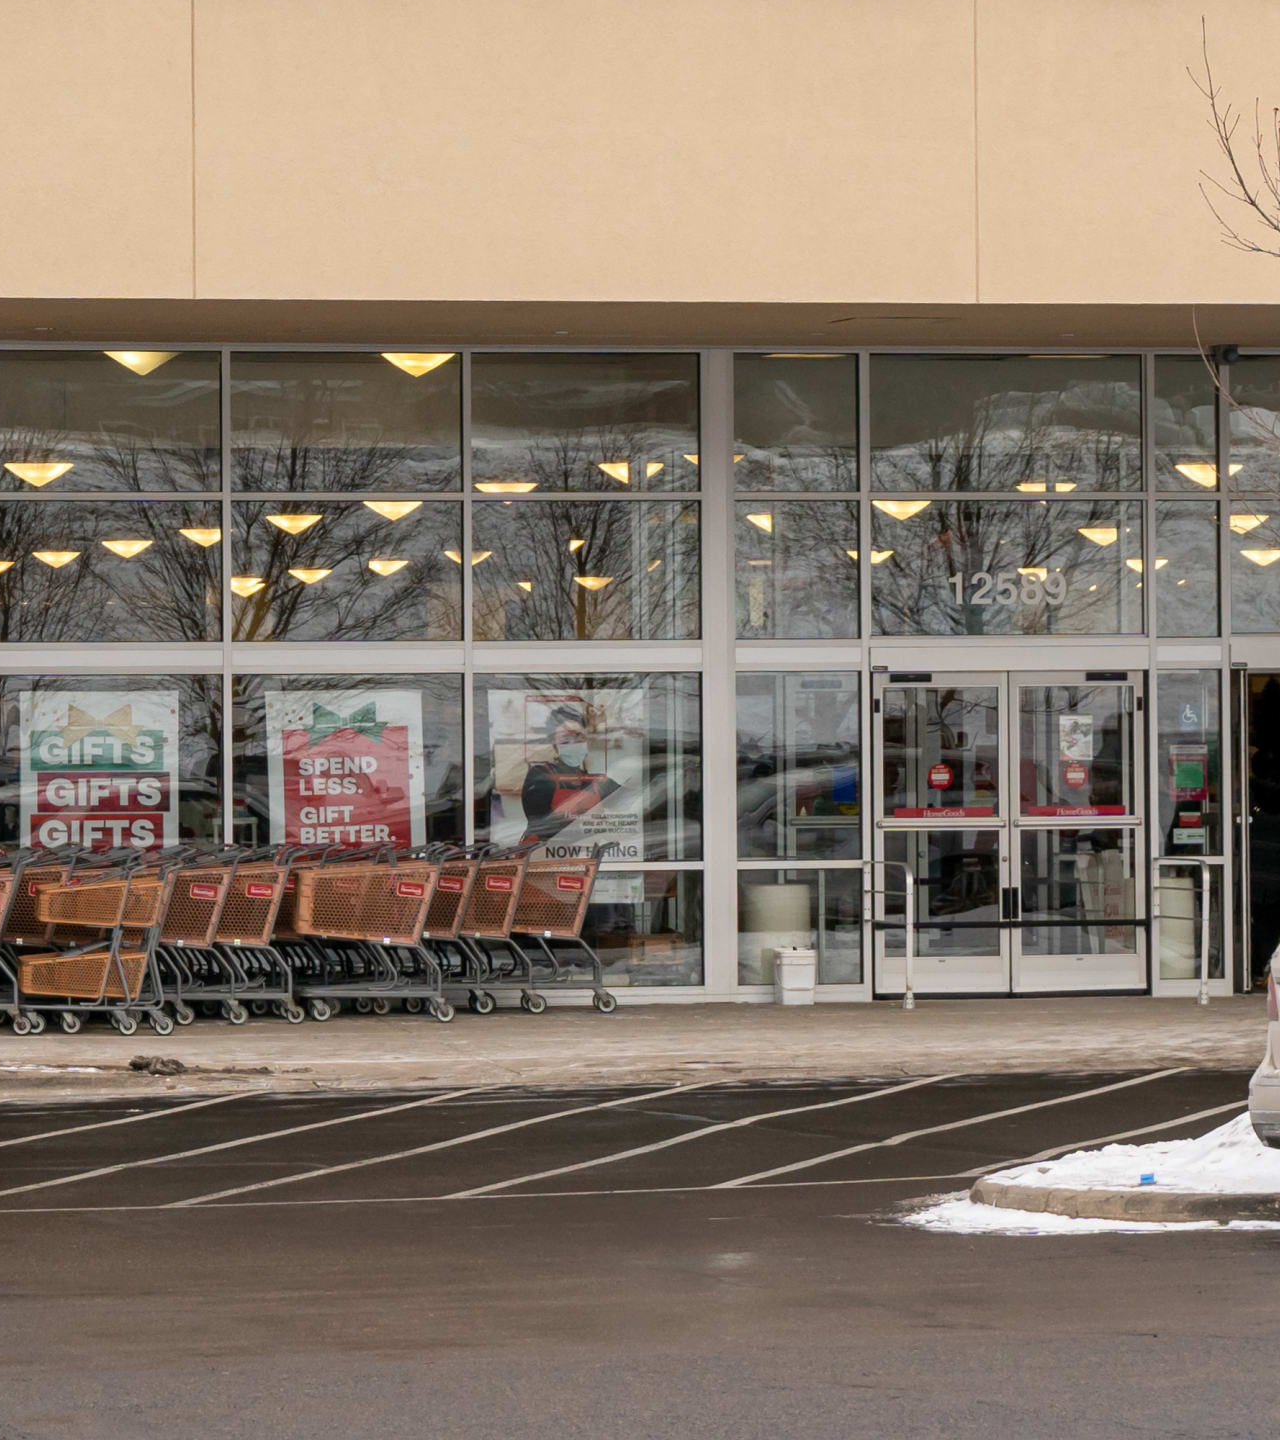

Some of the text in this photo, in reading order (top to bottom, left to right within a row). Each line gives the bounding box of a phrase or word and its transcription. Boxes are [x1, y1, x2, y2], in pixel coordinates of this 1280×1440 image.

[948, 571, 1068, 605] 12589
[38, 735, 156, 765] GIFTS
[298, 755, 378, 776] SPEND
[45, 777, 162, 807] GIFTS
[299, 777, 364, 796] LESS.
[300, 805, 354, 825] GIFT
[38, 818, 156, 849] GIFTS
[300, 824, 397, 845] BETTER.
[545, 845, 582, 859] NOW
